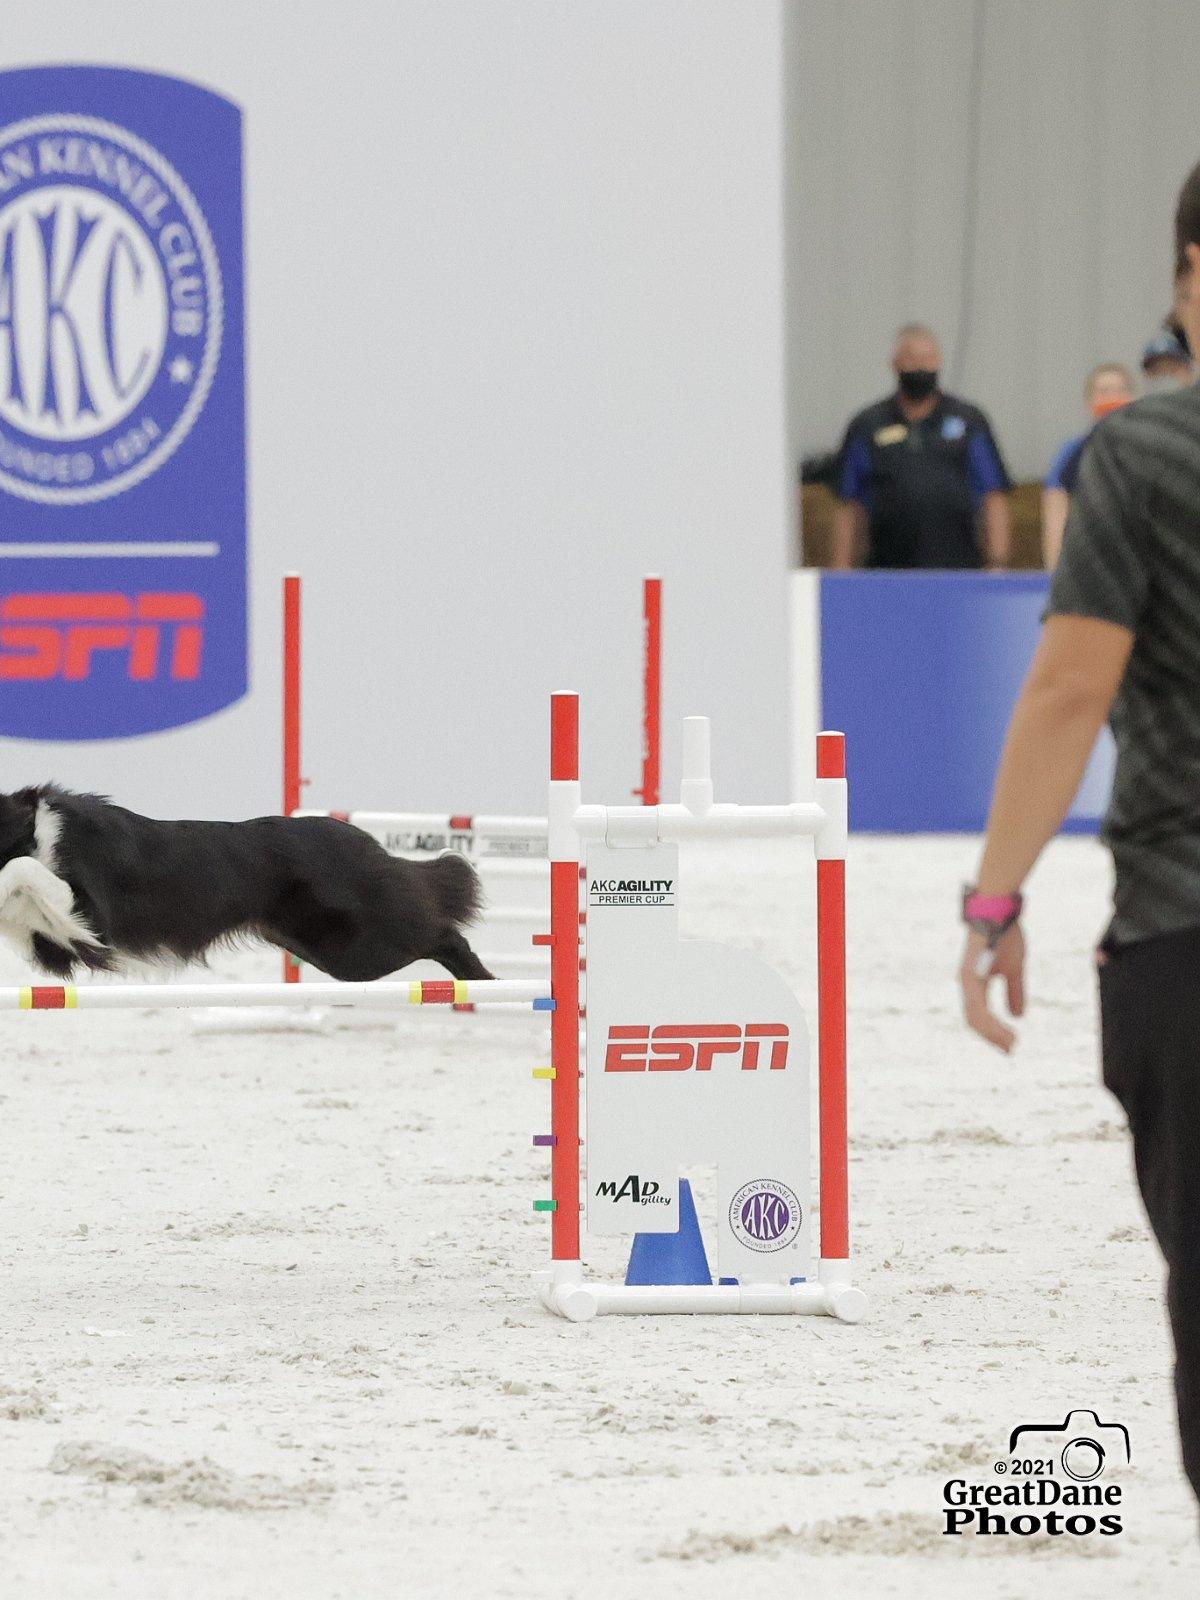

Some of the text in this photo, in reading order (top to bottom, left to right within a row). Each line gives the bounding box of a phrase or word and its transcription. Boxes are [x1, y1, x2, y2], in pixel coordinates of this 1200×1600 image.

[39, 137, 170, 229] KENNEL
[159, 222, 201, 336] CLUB
[599, 895, 666, 904] PREMIER CUP
[604, 1023, 789, 1072] ESPN
[732, 1183, 798, 1222] AMERICAN KENNEL CLUB
[743, 1194, 787, 1239] AKC
